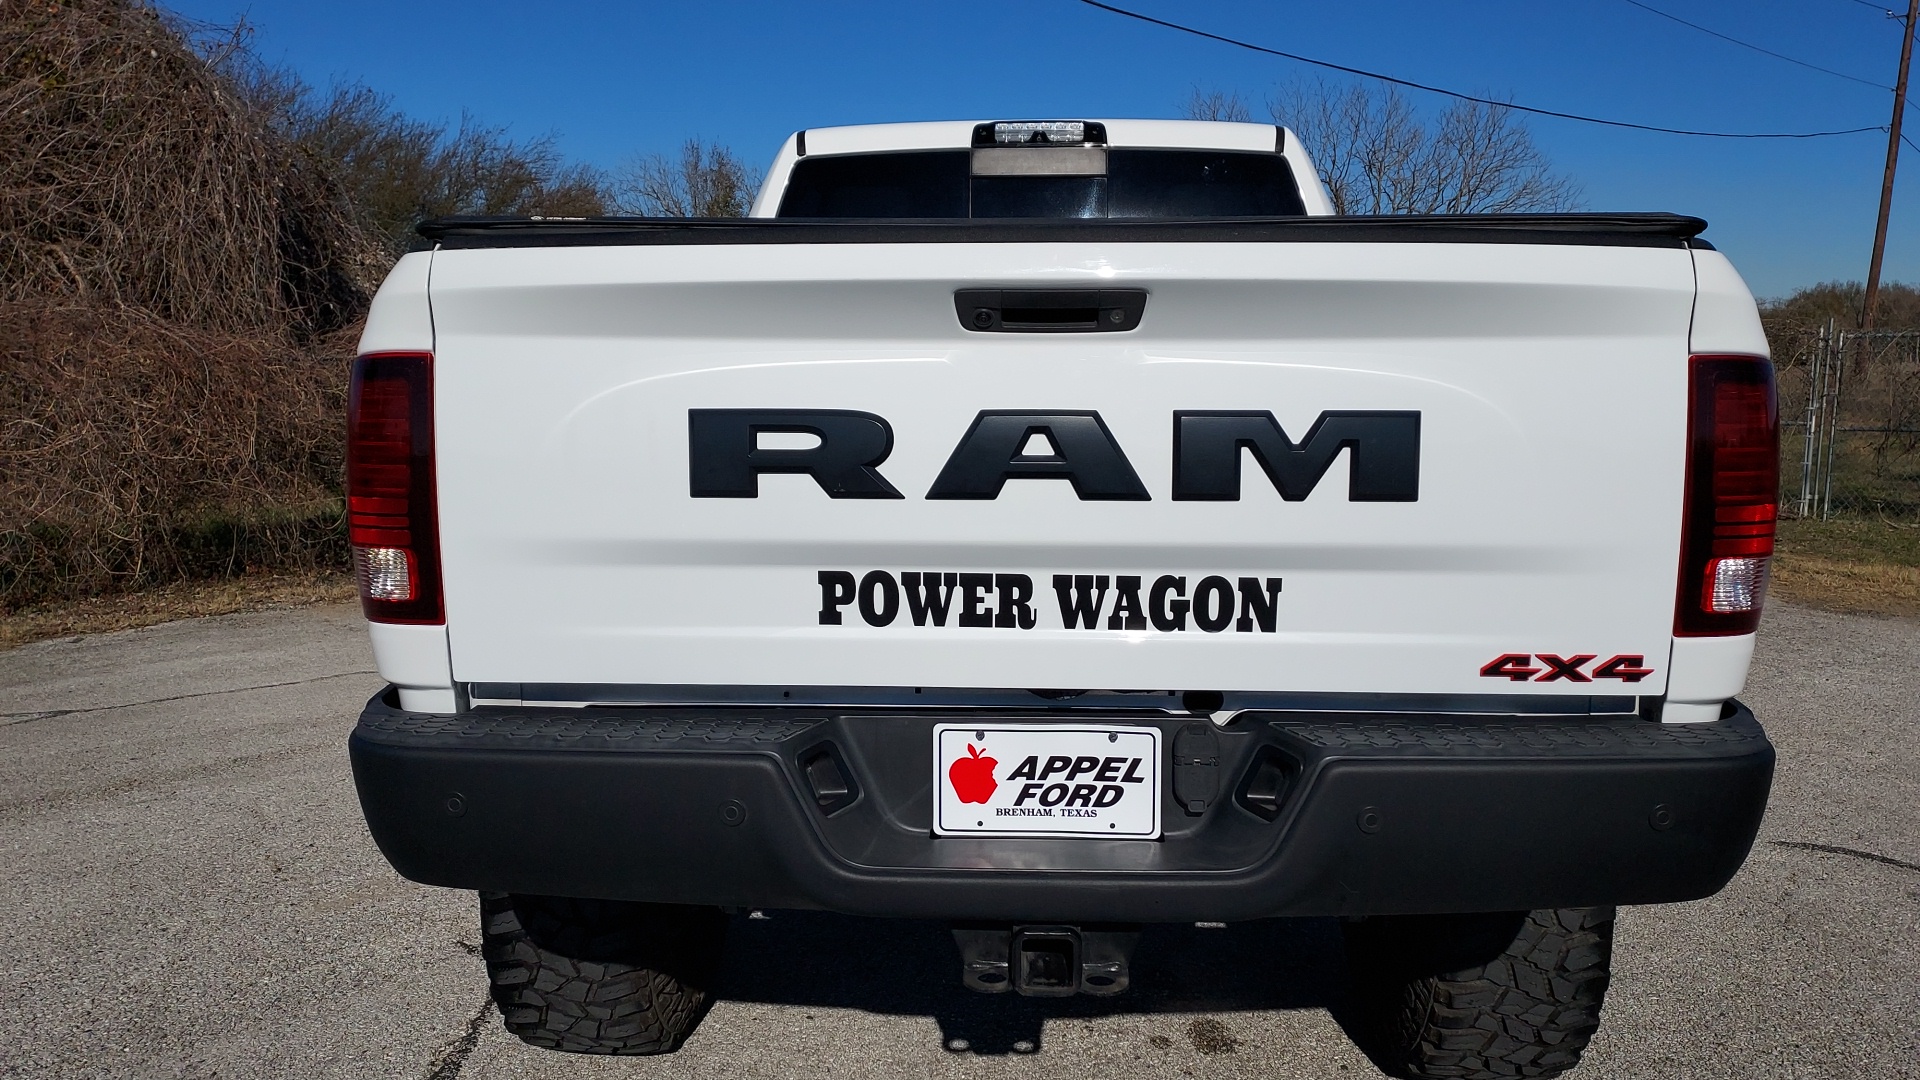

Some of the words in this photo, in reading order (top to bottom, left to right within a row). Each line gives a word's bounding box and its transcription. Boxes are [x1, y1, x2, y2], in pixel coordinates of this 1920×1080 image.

[688, 408, 1421, 502] RAM
[817, 569, 1037, 629] POWER
[1052, 574, 1283, 633] WAGON
[1006, 755, 1145, 783] APPEL
[1013, 783, 1125, 808] FORD
[995, 807, 1056, 818] BRENHAM,
[1059, 808, 1098, 818] TEXAS
